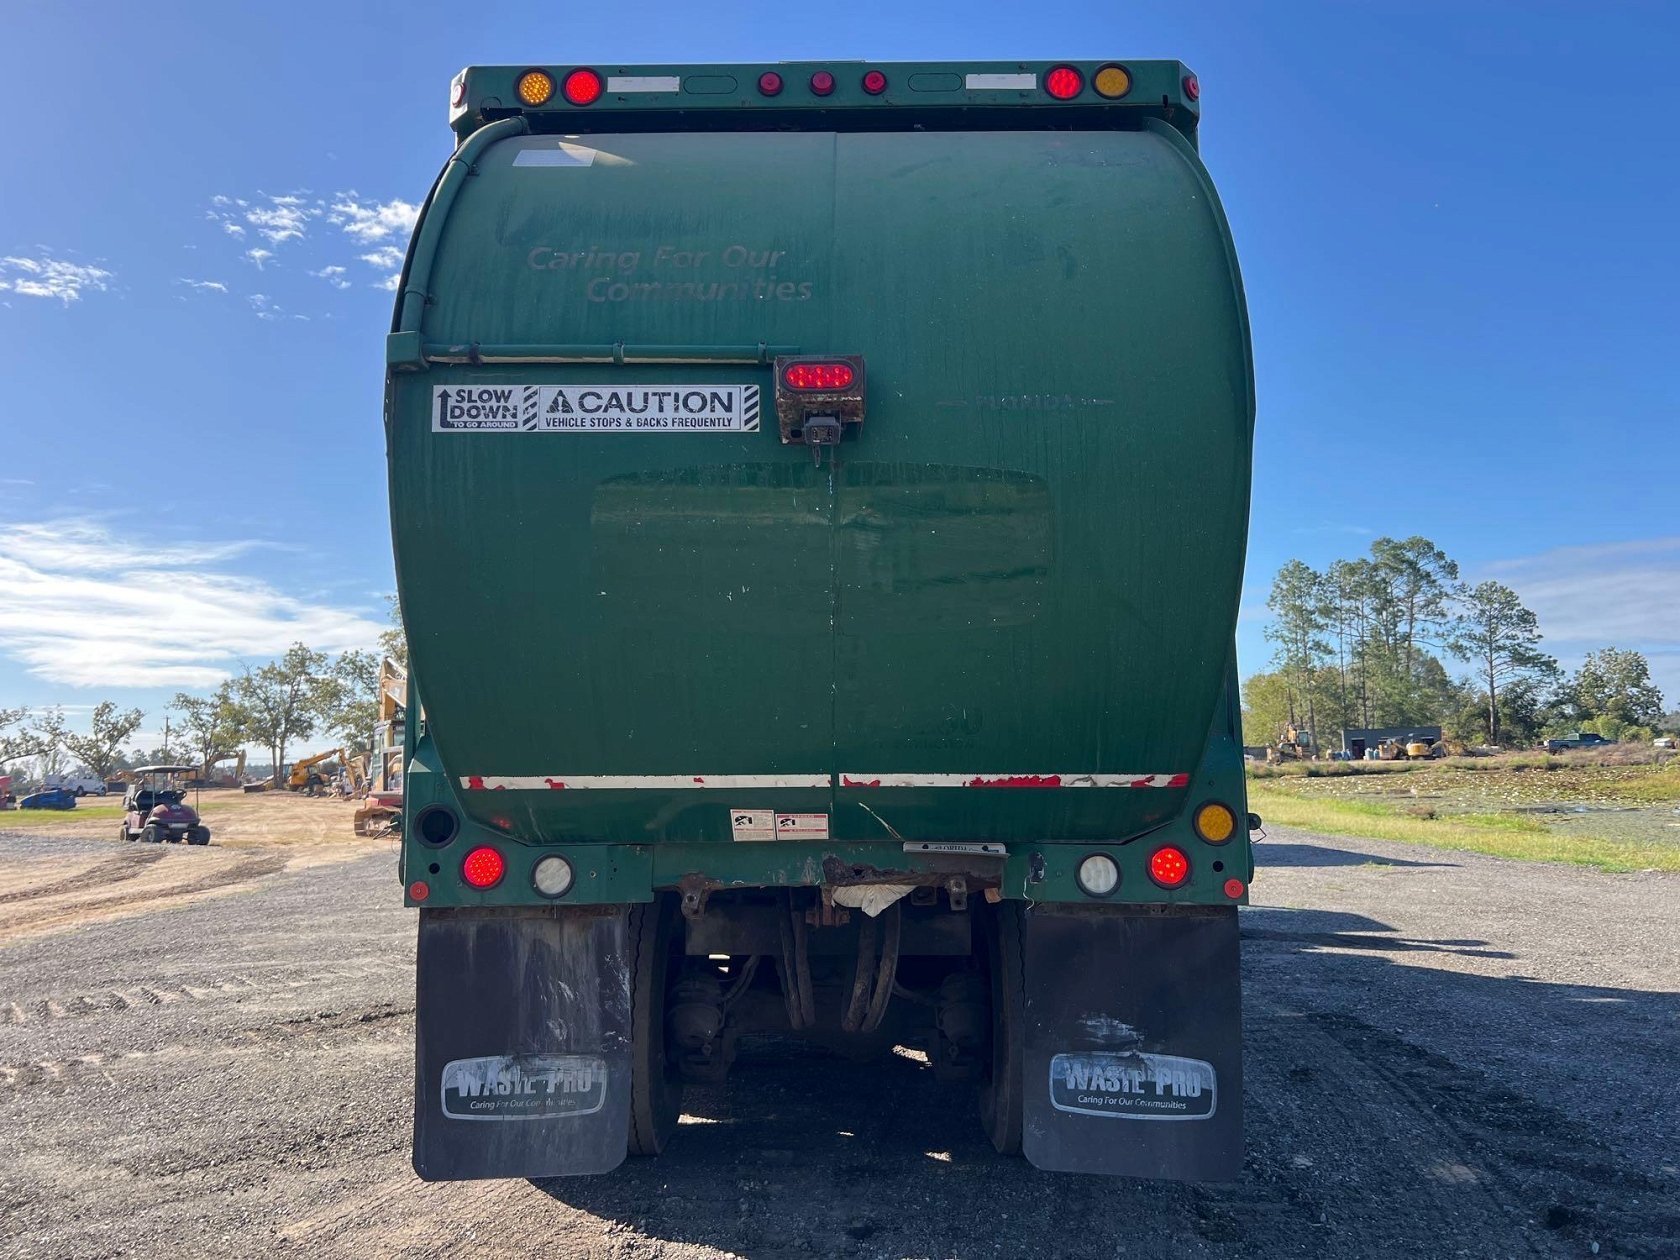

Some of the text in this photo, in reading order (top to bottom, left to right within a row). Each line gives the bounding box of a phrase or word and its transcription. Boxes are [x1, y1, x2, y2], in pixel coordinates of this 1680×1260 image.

[527, 245, 787, 275] Caring For Our
[455, 389, 513, 404] SLOW
[578, 391, 733, 414] CAUTION
[450, 405, 518, 419] DOWN
[546, 417, 733, 428] VEHICLE STOPS & BACKS FREQUENTLY
[1064, 1063, 1202, 1098] WASTE PRO
[470, 1101, 495, 1110] Caring
[510, 1099, 525, 1107] Our
[1077, 1095, 1187, 1109] Caring For Our Communities
